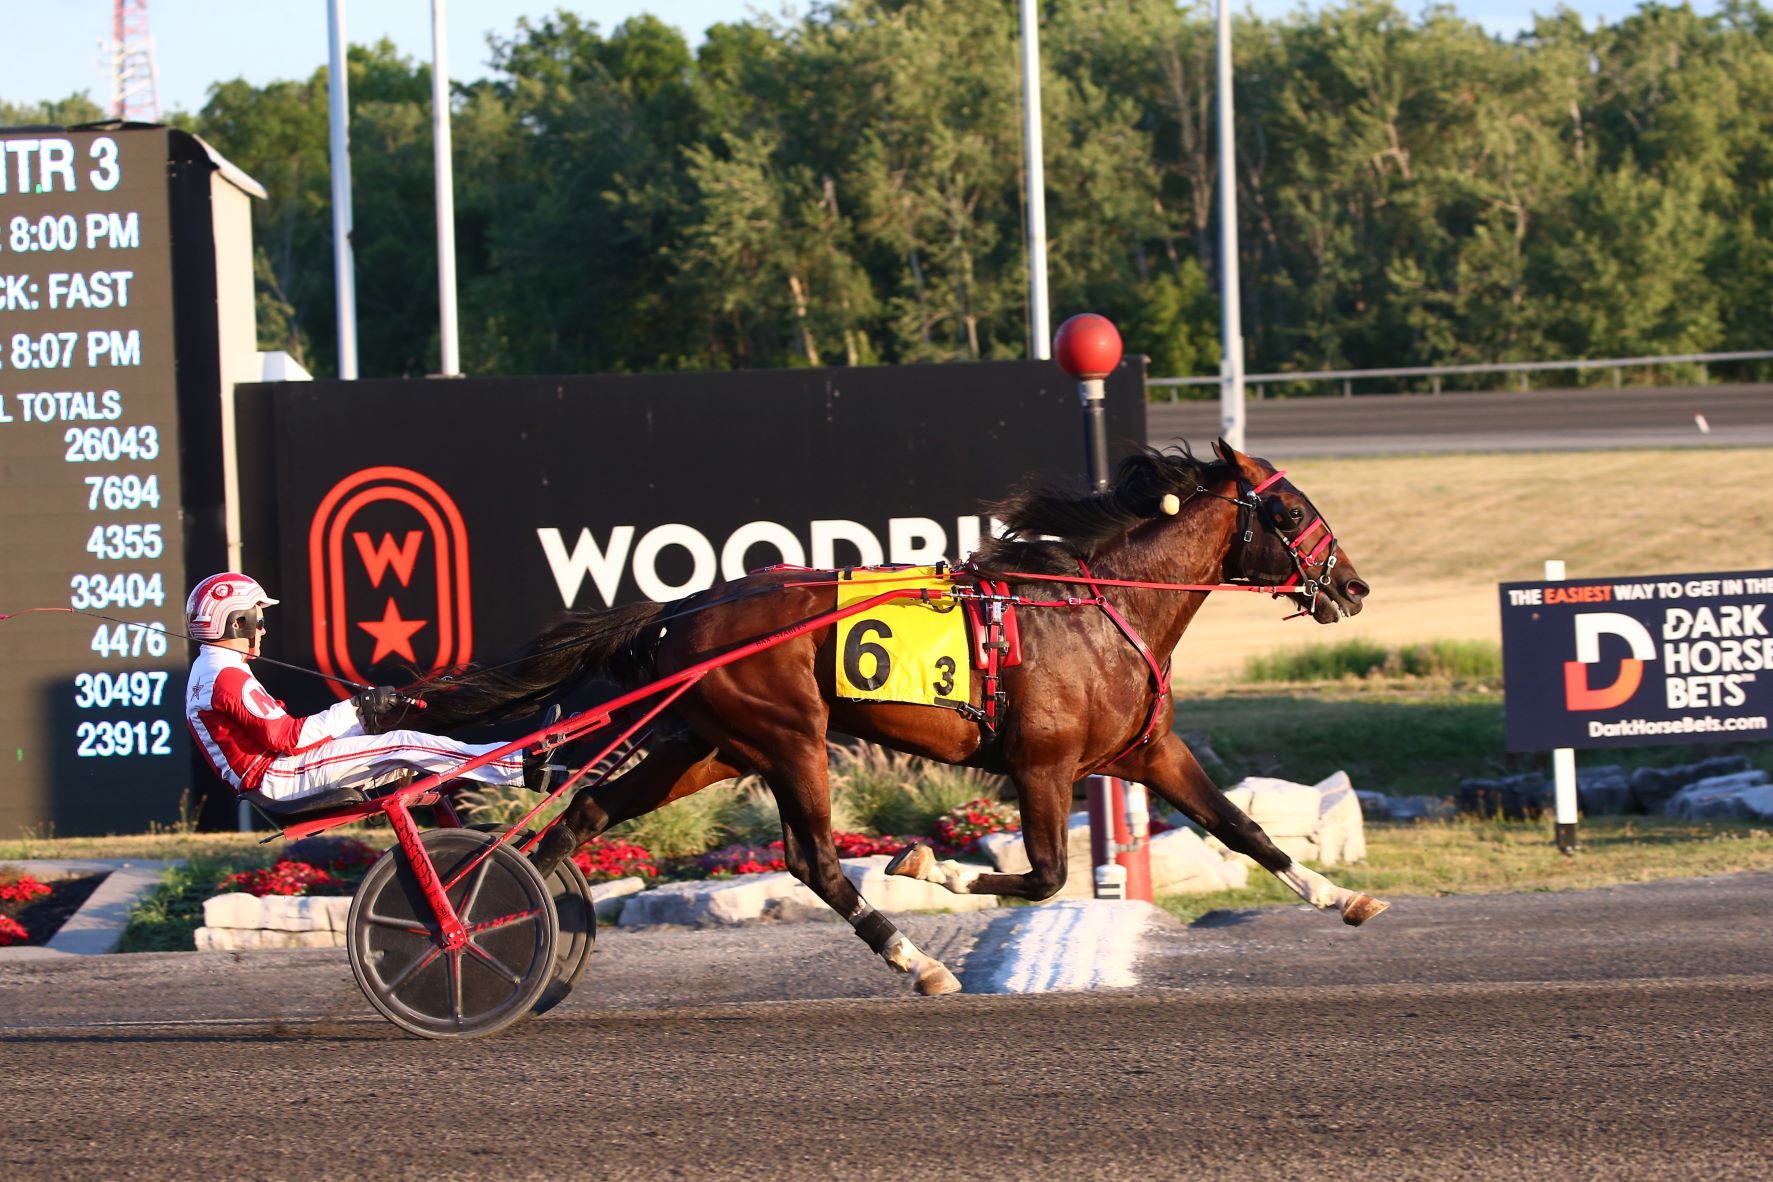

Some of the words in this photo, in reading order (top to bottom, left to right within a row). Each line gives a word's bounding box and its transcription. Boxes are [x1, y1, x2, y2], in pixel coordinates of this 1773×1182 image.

[89, 137, 120, 191] 3
[10, 215, 77, 251] 8:00
[86, 212, 139, 248] PM
[48, 271, 133, 309] FAST
[11, 332, 77, 369] 8:07
[87, 330, 141, 367] PM
[17, 390, 122, 422] TOTALS
[64, 426, 159, 462] 26043
[85, 475, 160, 510] 7694
[86, 524, 163, 559] 4355
[353, 530, 424, 589] W
[71, 573, 164, 609] 33404
[1508, 589, 1542, 606] THE
[1543, 585, 1612, 604] EASIEST
[1613, 583, 1656, 601] WAY
[1657, 582, 1683, 599] TO
[1684, 580, 1721, 598] GET
[1722, 579, 1744, 596] IN
[1662, 603, 1769, 640] DARK
[91, 623, 167, 658] 4476
[843, 618, 893, 691] 6
[933, 655, 956, 696] 3
[75, 672, 168, 708] 30497
[1665, 673, 1746, 709] BETS
[76, 720, 172, 757] 23912
[1588, 715, 1768, 738] DarkHorseBets.com
